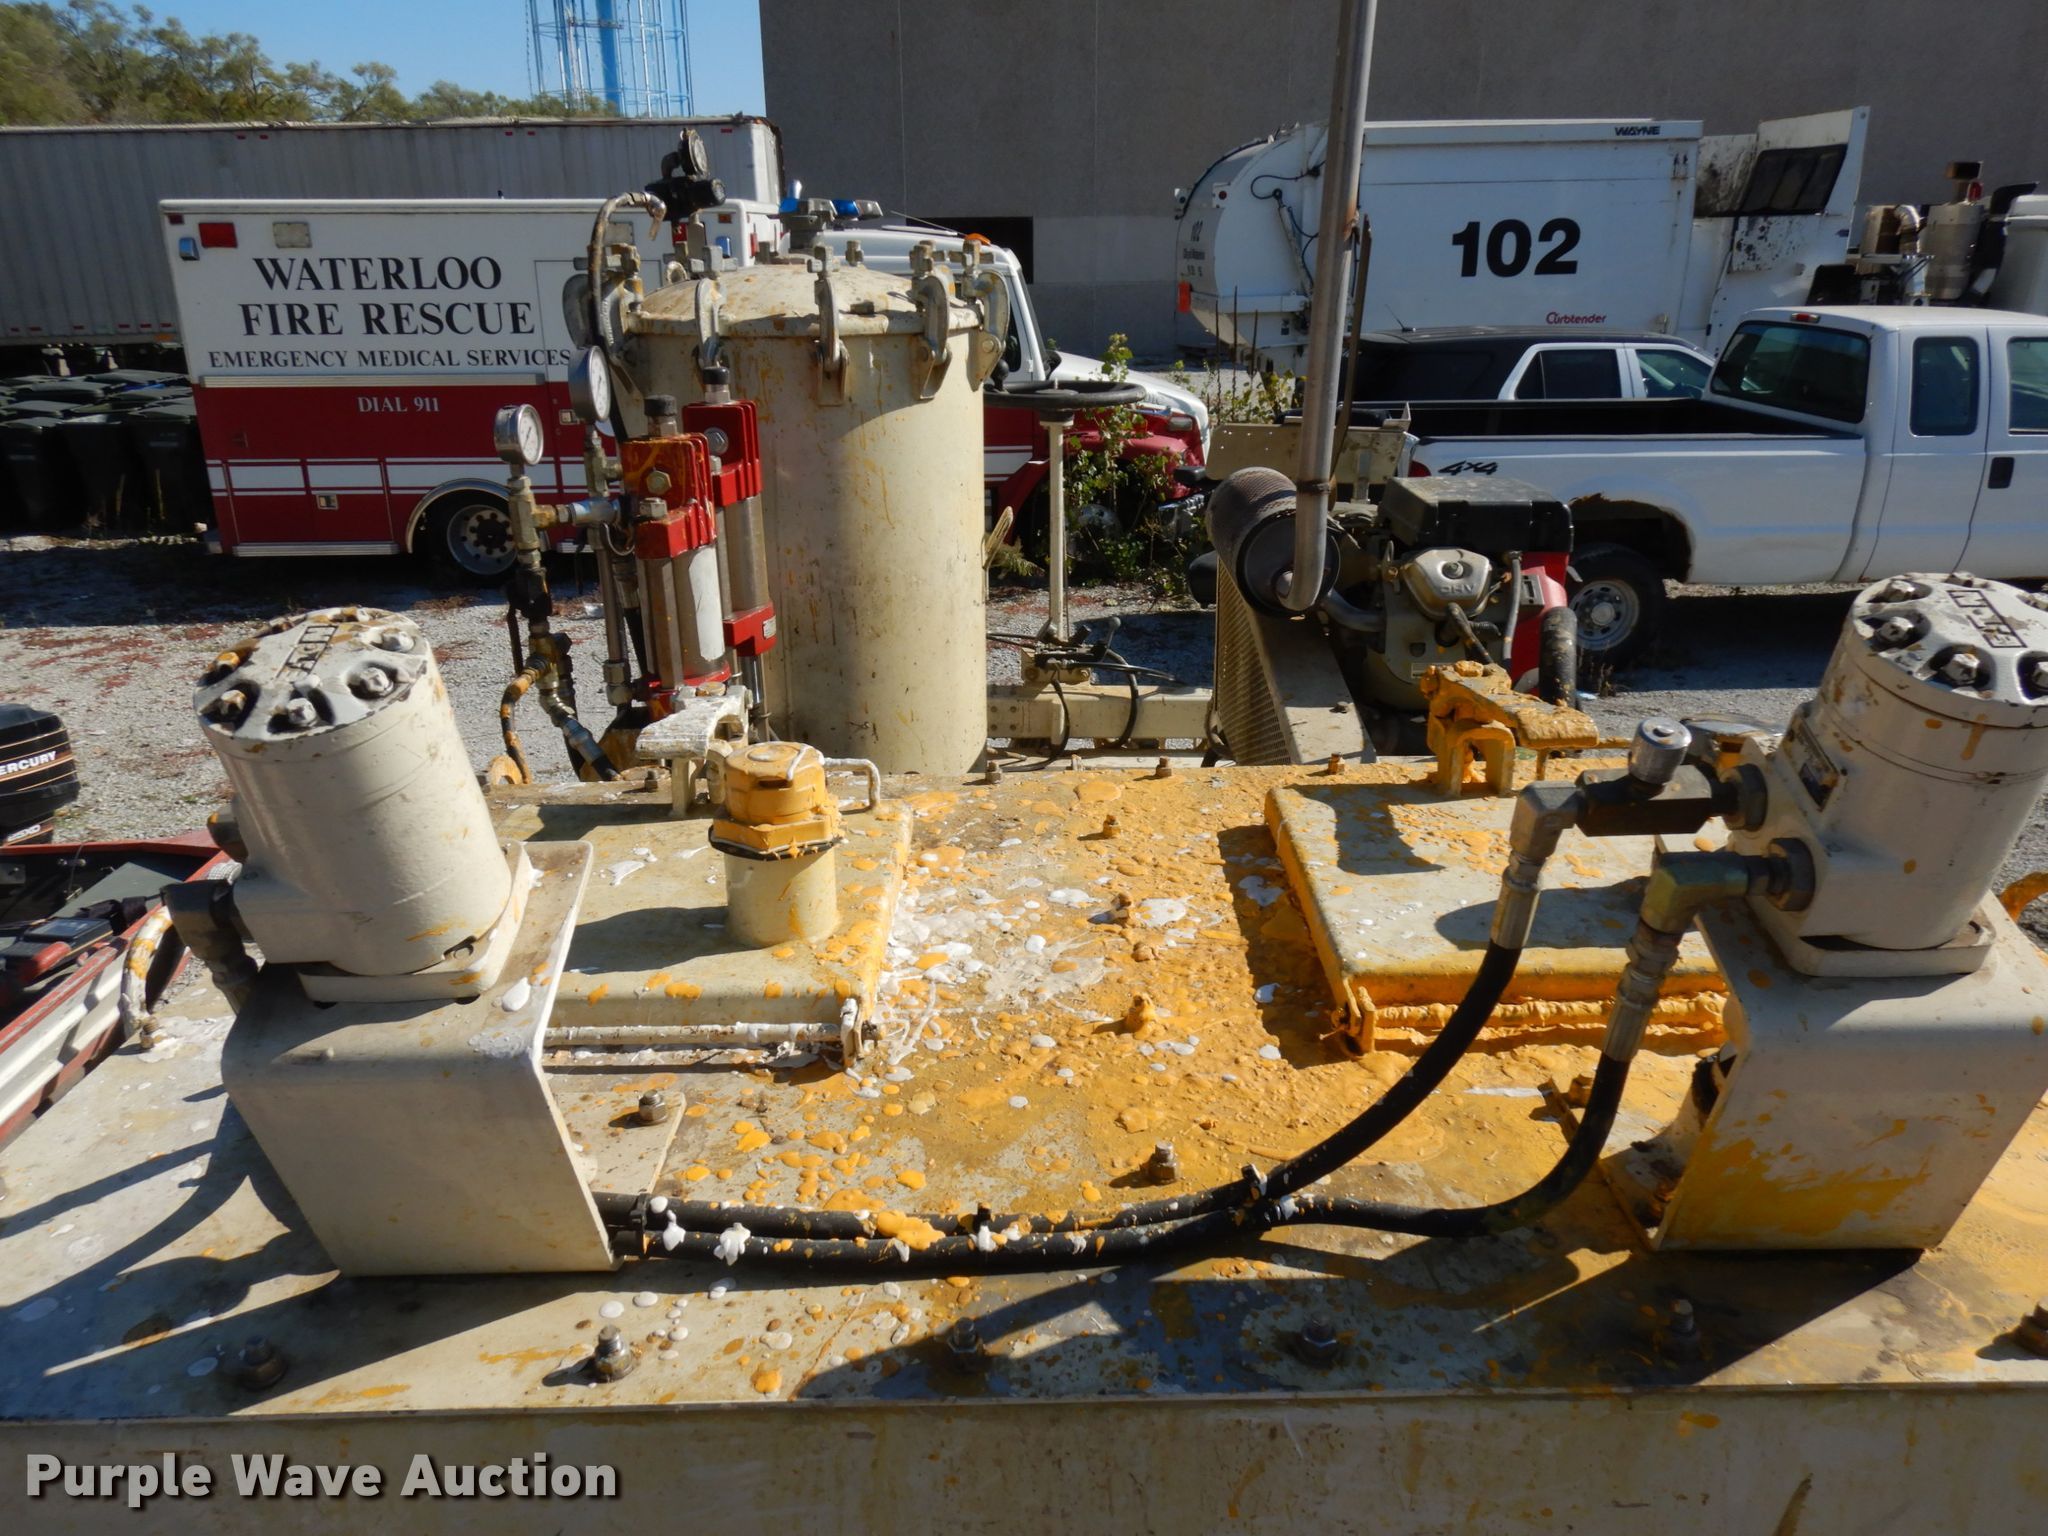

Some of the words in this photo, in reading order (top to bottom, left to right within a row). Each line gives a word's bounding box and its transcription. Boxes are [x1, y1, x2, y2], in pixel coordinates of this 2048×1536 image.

[1614, 125, 1660, 136] WAYNE
[1452, 218, 1580, 277] 102
[252, 256, 502, 290] WATERLOO
[238, 303, 344, 336] FIRE
[359, 302, 535, 335] RESCUE
[1546, 311, 1606, 325] Curbtender
[209, 351, 348, 368] EMERGENCY
[358, 350, 460, 367] MEDICAL
[467, 349, 571, 366] SERVICES
[357, 397, 408, 413] DIAL
[413, 396, 440, 412] 911
[1438, 460, 1498, 476] 4x4
[0, 751, 56, 775] ERCURY
